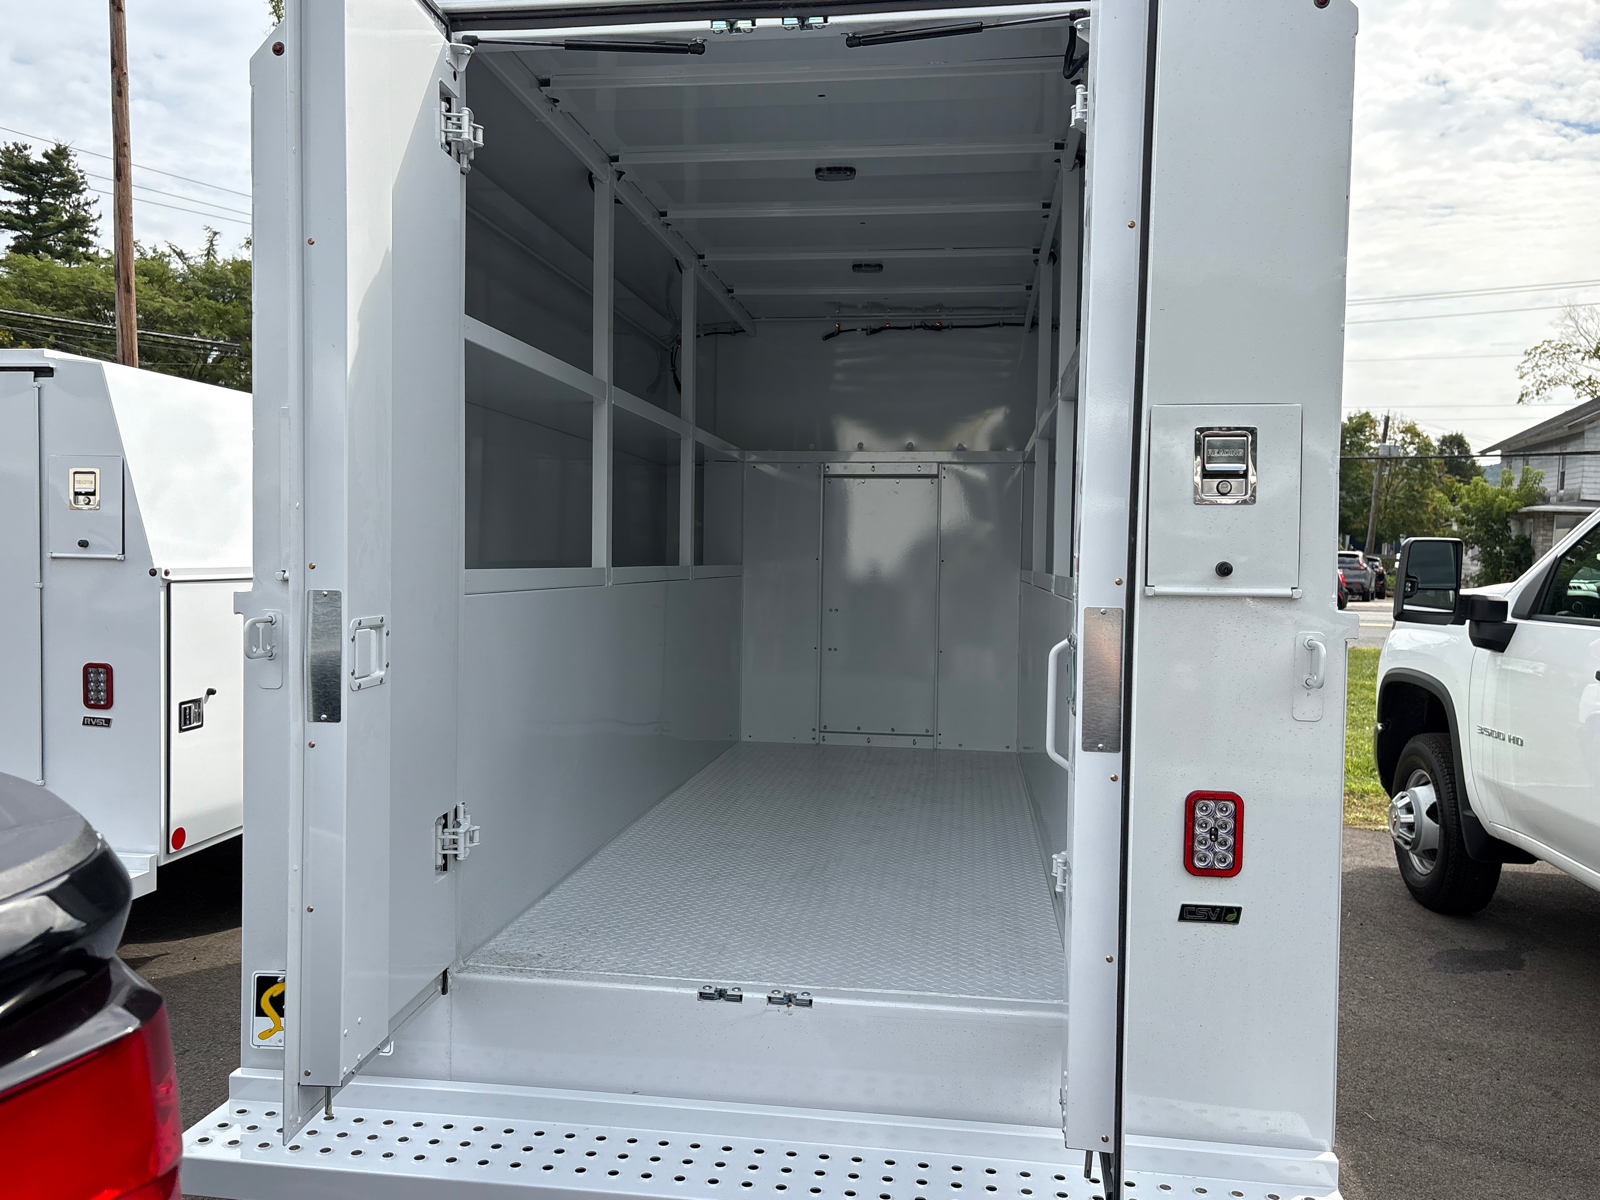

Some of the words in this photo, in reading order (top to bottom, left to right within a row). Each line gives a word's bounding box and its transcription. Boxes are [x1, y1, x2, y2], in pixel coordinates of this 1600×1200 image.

[84, 717, 109, 727] RVSL
[1476, 724, 1505, 741] 3500
[1507, 733, 1524, 747] HD
[1183, 906, 1221, 921] CSV
